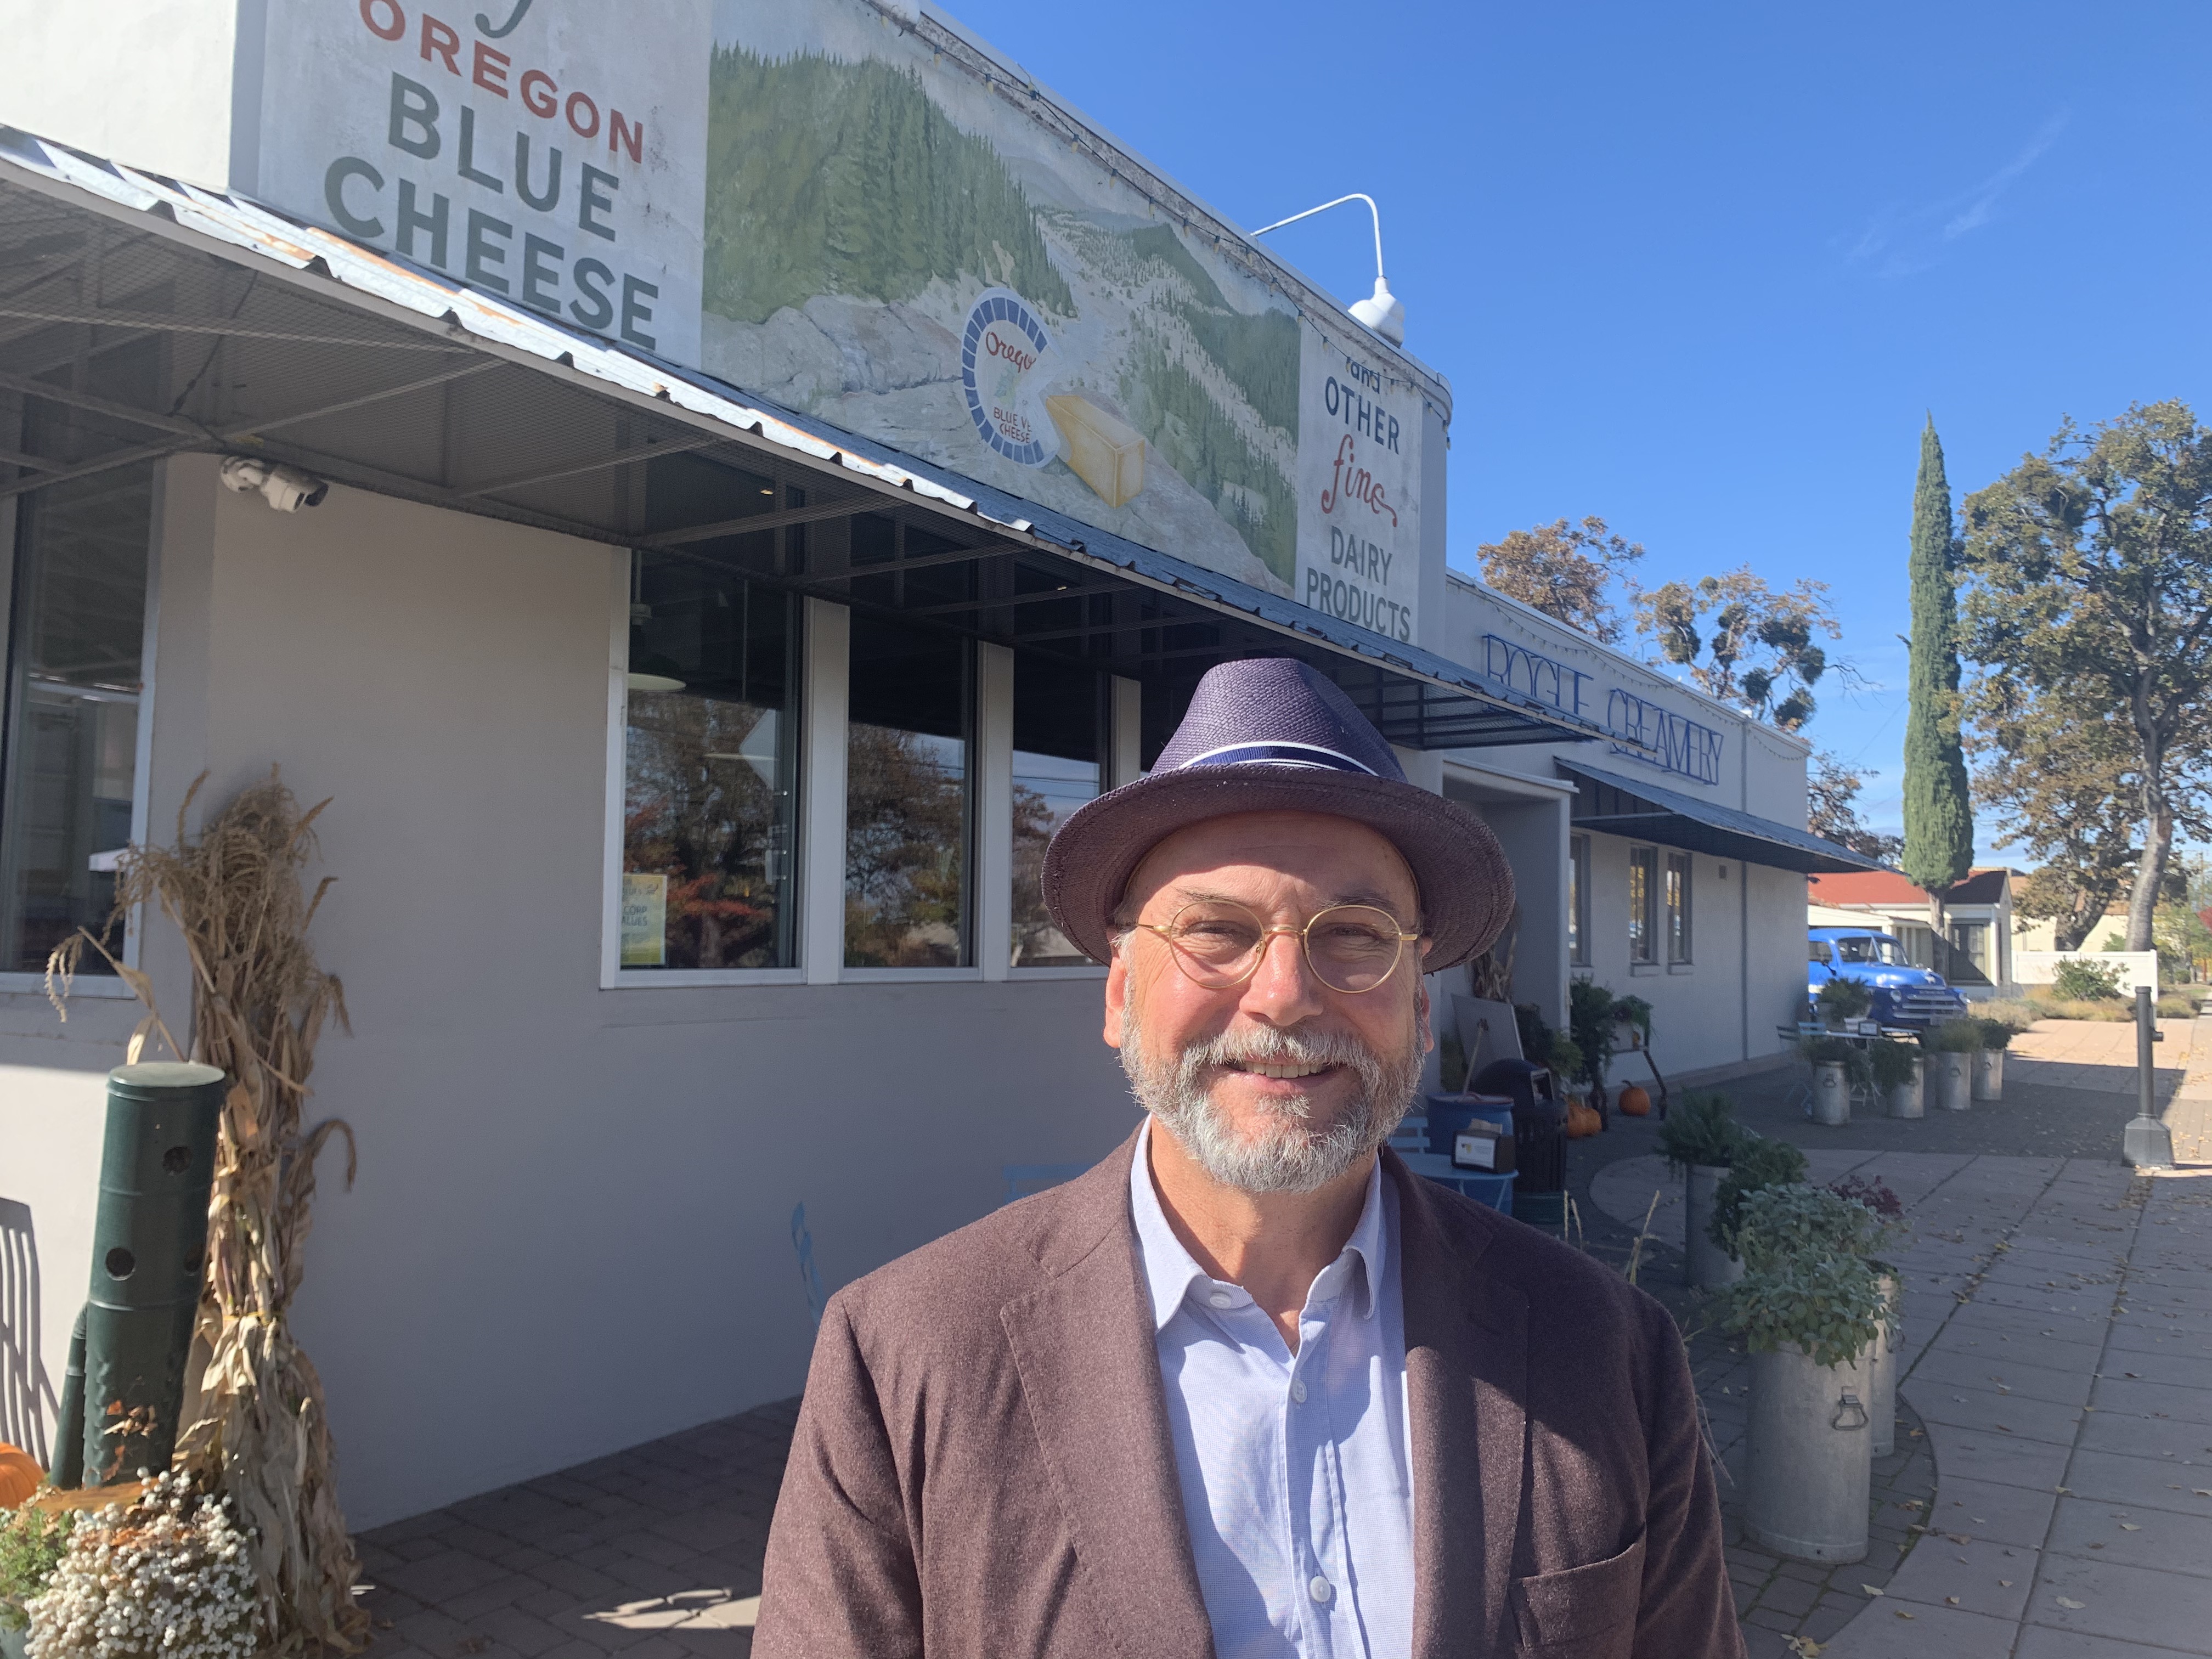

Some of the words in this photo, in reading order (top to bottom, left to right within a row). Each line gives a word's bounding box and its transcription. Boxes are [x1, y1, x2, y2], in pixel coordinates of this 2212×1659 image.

[359, 0, 644, 163] OREGON
[388, 71, 619, 242] BLUE
[324, 156, 659, 351] CHEESE
[994, 407, 1018, 426] BLUE
[1325, 376, 1400, 455] OTHER
[1351, 362, 1380, 394] and
[1000, 423, 1030, 444] CHEESE
[1321, 434, 1397, 527] fine
[1331, 526, 1393, 586] DAIRY
[1307, 567, 1411, 642] PRODUCTS
[1608, 688, 1724, 786] CREAMERY
